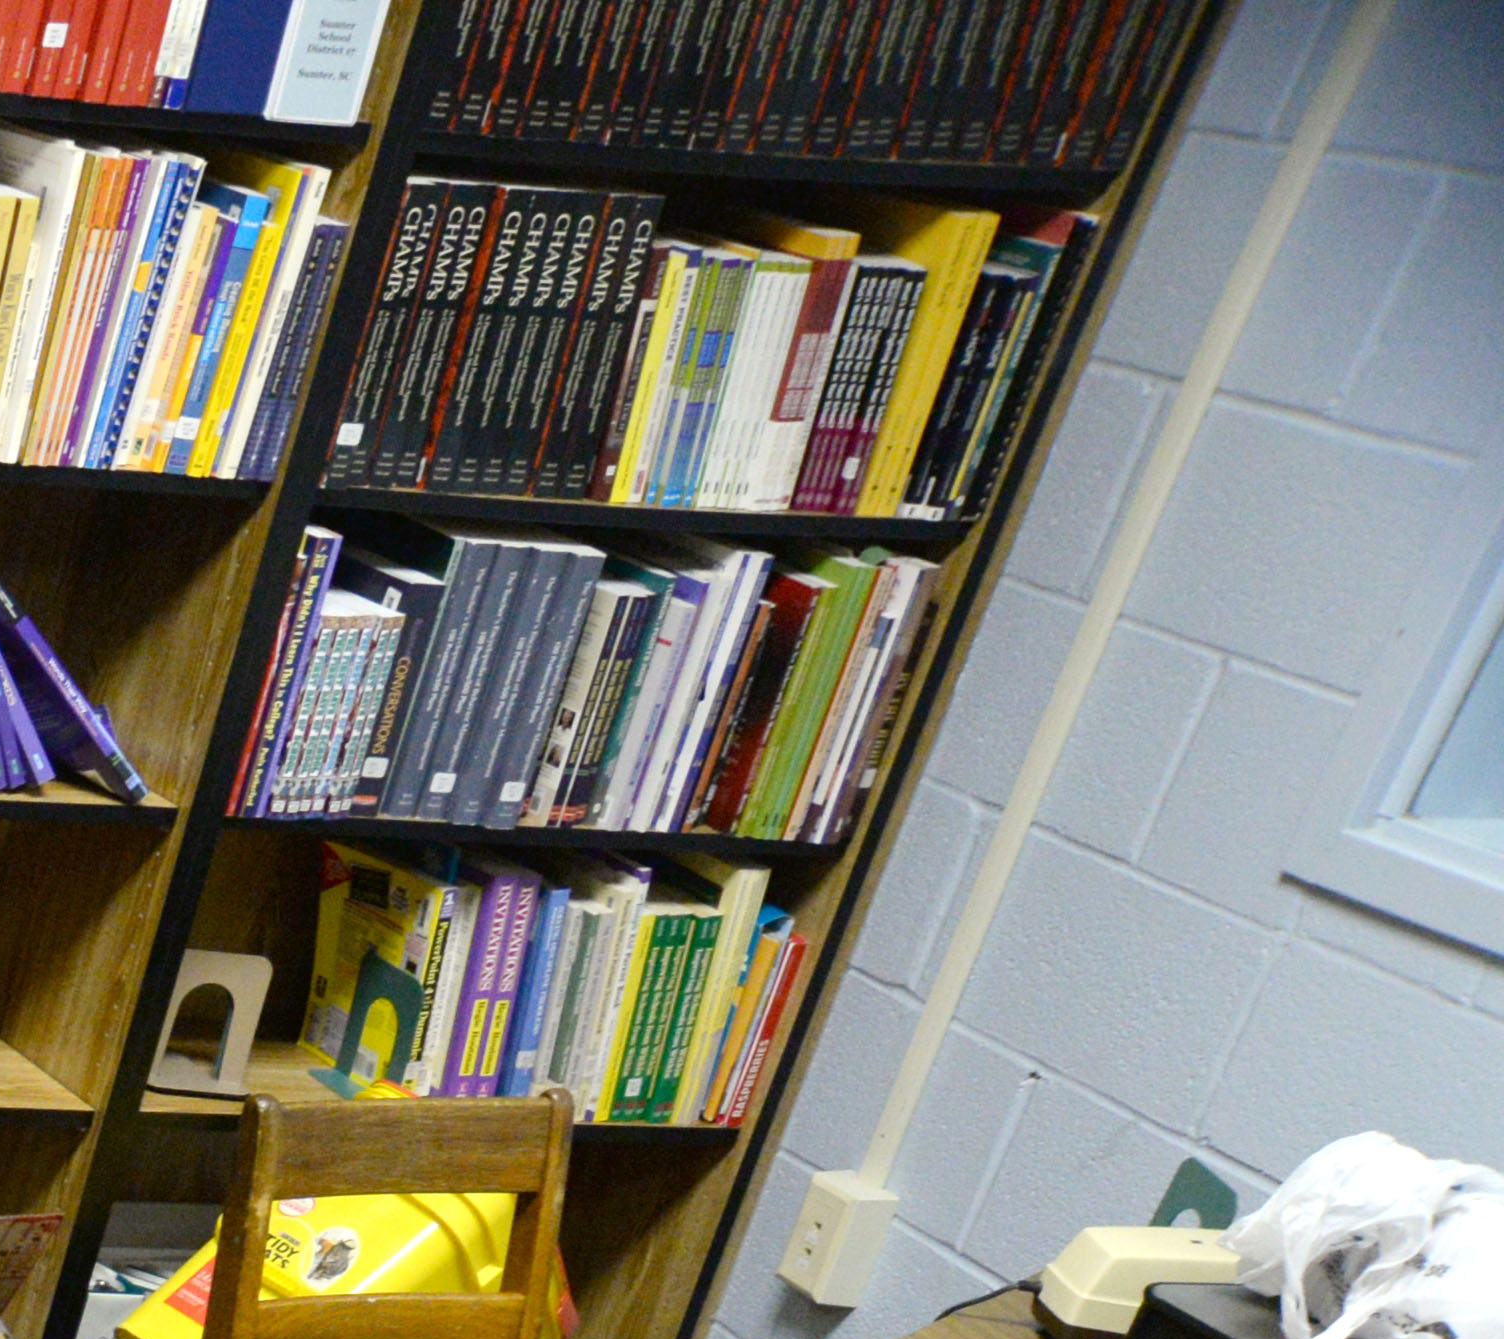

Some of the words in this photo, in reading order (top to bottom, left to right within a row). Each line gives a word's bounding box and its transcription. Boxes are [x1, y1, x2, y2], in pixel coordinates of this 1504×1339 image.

[306, 43, 343, 56] District
[318, 31, 351, 43] School
[320, 19, 355, 31] Sumter
[297, 68, 335, 81] Sumter,
[339, 71, 352, 81] SC
[382, 207, 423, 301] CHAMPs
[426, 206, 465, 300] CHAMPs
[447, 206, 486, 300] CHAMPs
[483, 211, 522, 306] CHAMPs
[508, 213, 547, 307] CHAMPs
[533, 213, 571, 308] CHAMPs
[557, 214, 596, 309] CHAMPs
[588, 218, 626, 313] CHAMPs
[615, 219, 653, 314] CHAMPs
[295, 599, 313, 627] Didn't
[305, 574, 320, 595] Why
[278, 667, 294, 686] This
[285, 639, 302, 663] Learn
[264, 700, 284, 738] College?
[372, 656, 412, 755] CONVERSATIONS
[426, 921, 449, 984] PowerPoint
[478, 882, 514, 991] INVITATIONS
[498, 886, 534, 992] INVITATIONS
[264, 1248, 290, 1269] ATS
